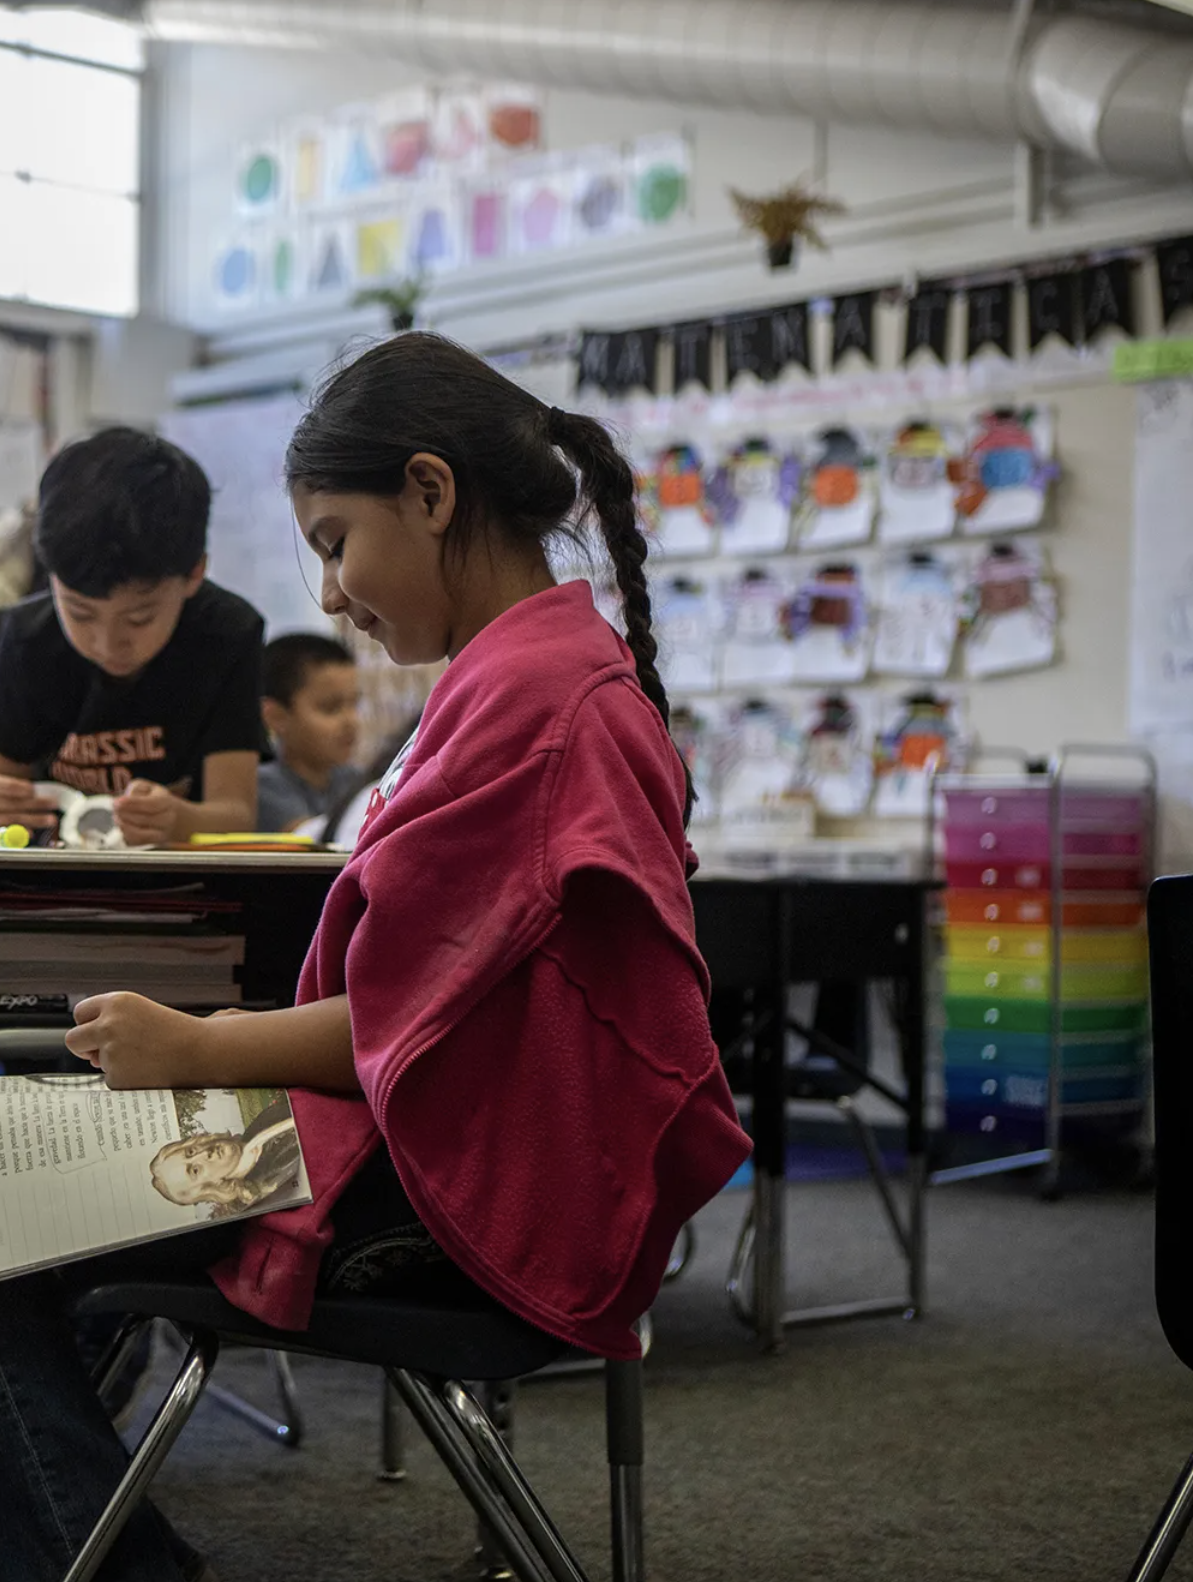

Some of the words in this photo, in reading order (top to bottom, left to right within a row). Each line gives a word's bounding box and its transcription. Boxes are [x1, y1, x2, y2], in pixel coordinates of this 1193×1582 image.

[149, 1121, 158, 1143] Newton
[23, 1138, 33, 1149] que
[63, 1135, 72, 1161] mantiene
[75, 1134, 86, 1158] flotando
[12, 1151, 23, 1173] porque
[25, 1150, 34, 1170] fuerza
[38, 1159, 46, 1167] de
